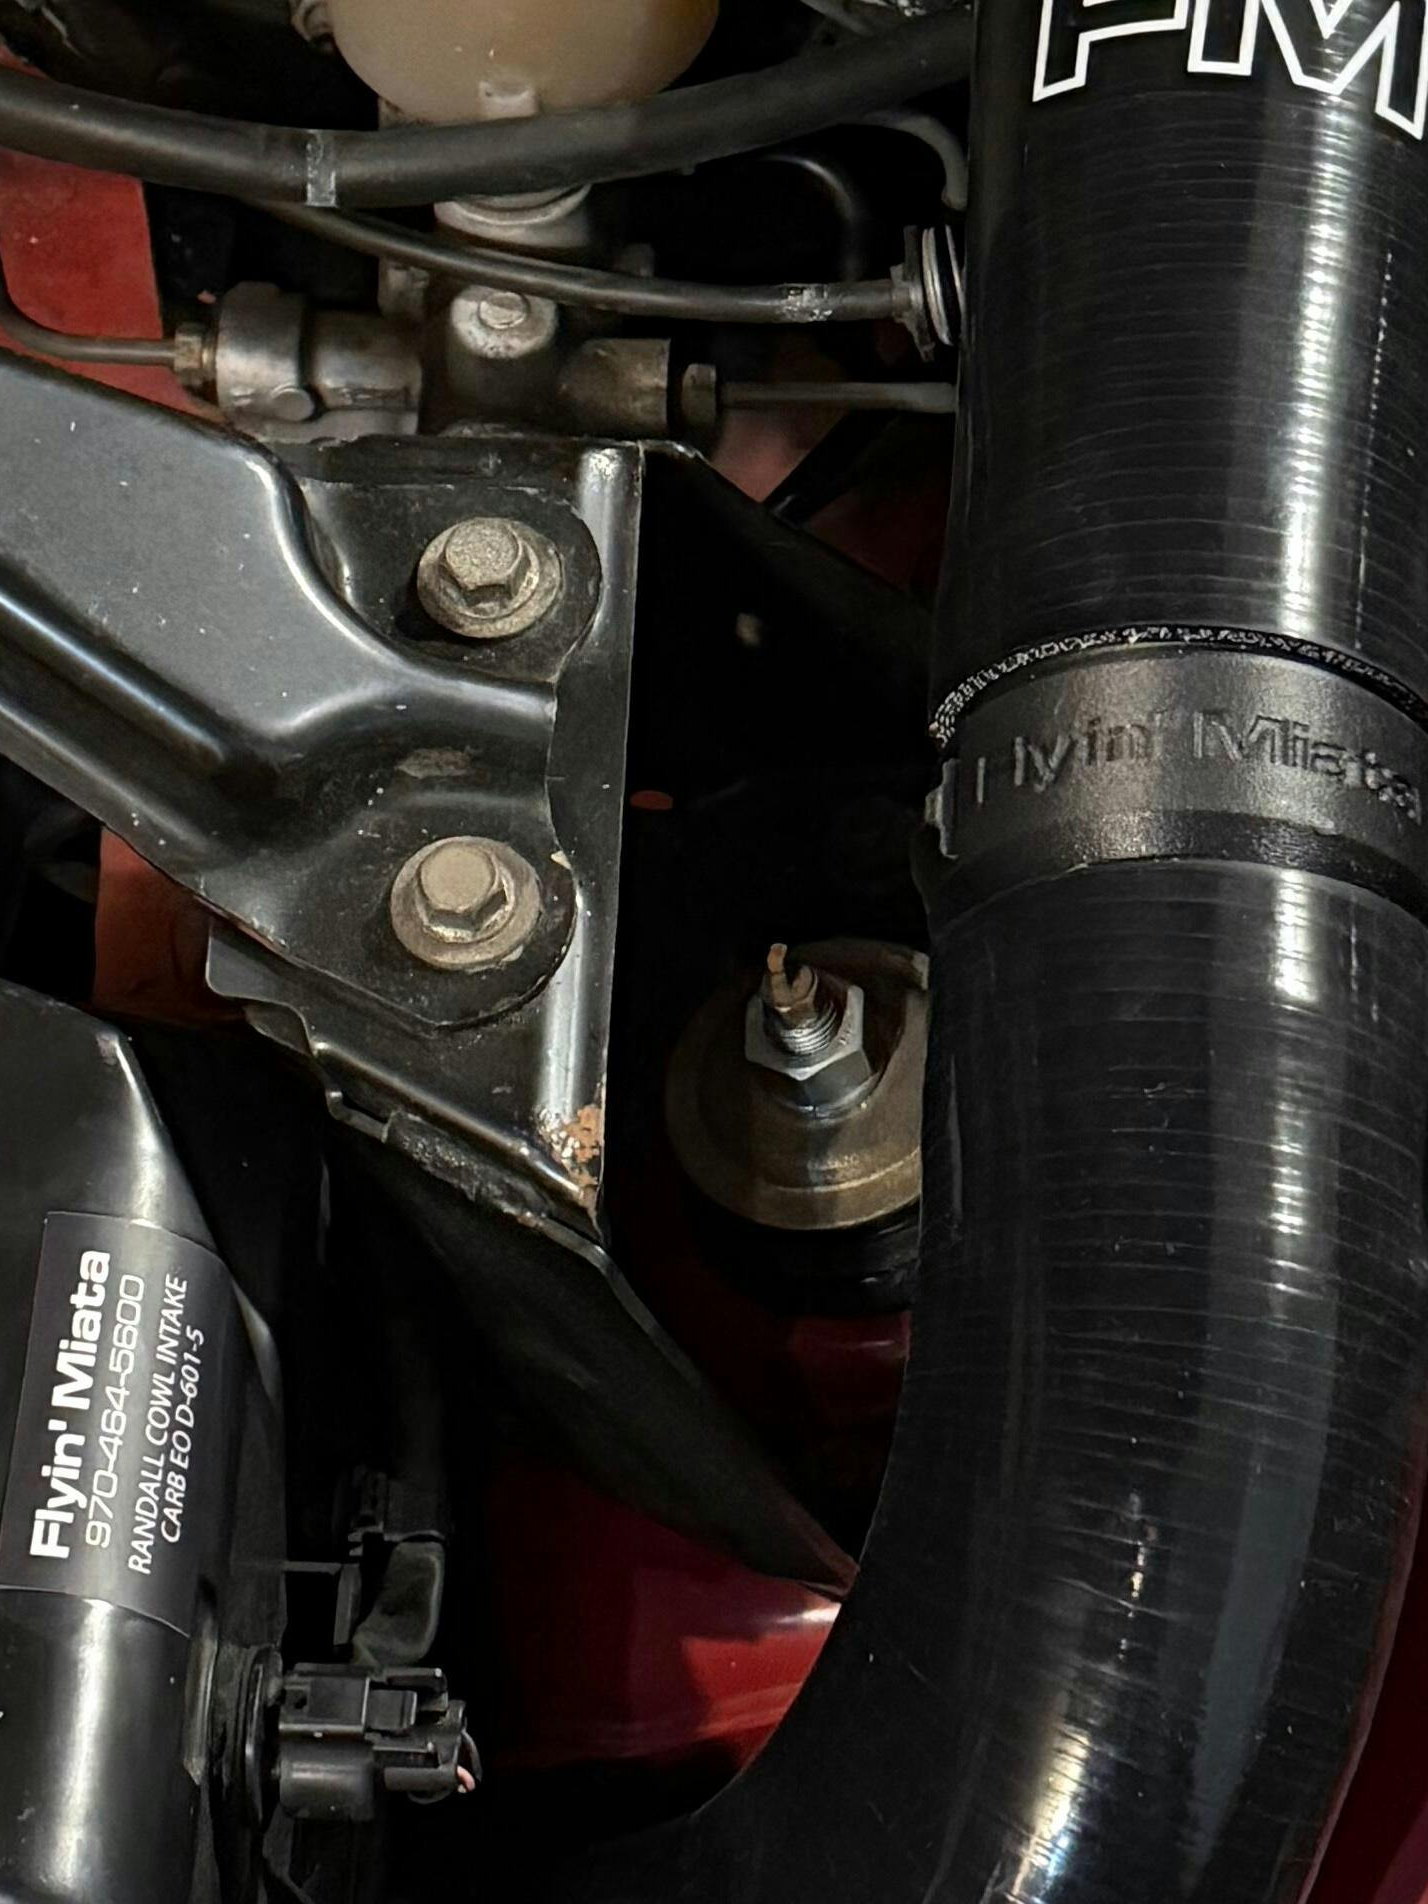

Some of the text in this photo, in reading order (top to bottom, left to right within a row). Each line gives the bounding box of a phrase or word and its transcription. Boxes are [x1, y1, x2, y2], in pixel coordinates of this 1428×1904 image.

[29, 1249, 111, 1560] Flyin' Miata
[84, 1274, 146, 1548] 970-464-5600
[128, 1272, 189, 1576] RANDALL COWL INTAKE
[160, 1324, 205, 1544] CARB EO D-601-5
